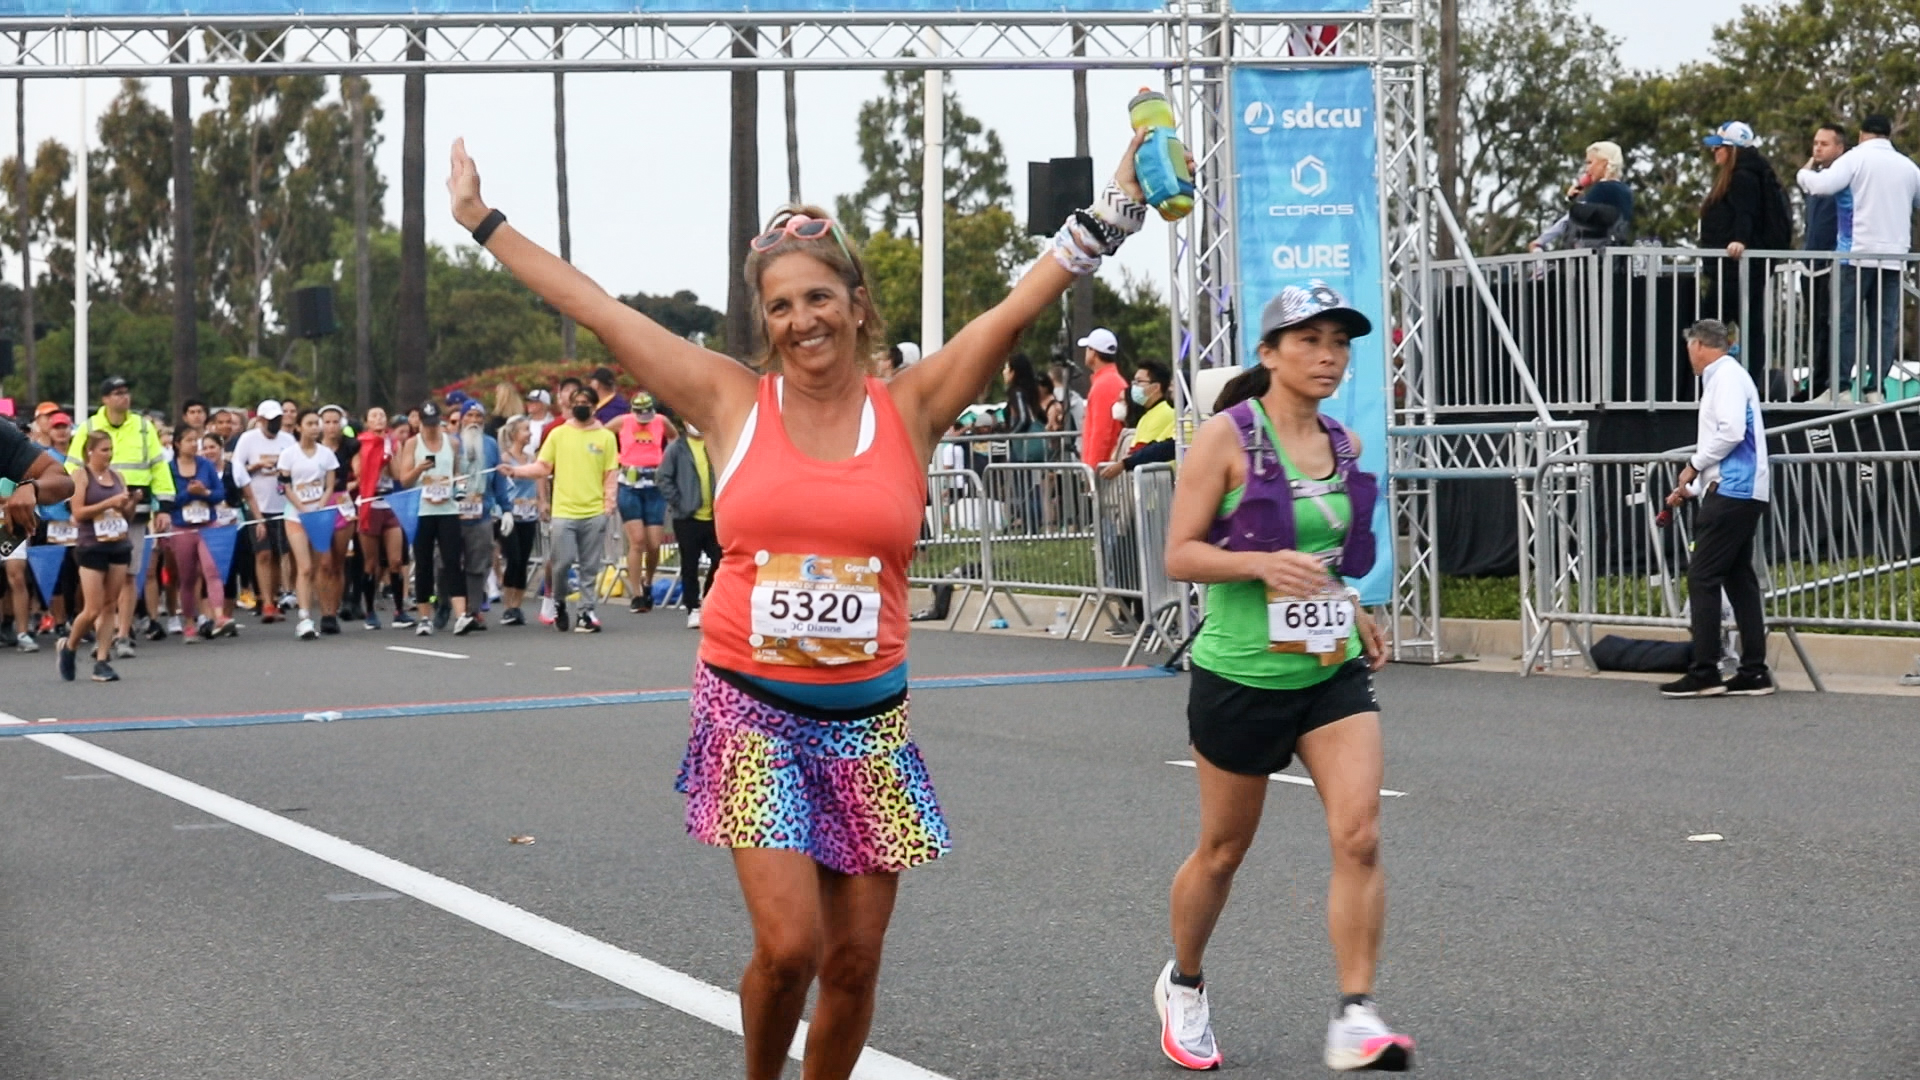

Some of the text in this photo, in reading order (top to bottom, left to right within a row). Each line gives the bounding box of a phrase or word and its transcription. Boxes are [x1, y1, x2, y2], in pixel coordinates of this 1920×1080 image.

[1282, 101, 1362, 129] sdccu
[1269, 203, 1354, 217] COROS
[1272, 244, 1350, 269] QURE
[855, 573, 863, 583] 2
[769, 589, 863, 624] 5320
[807, 623, 842, 634] Dianne
